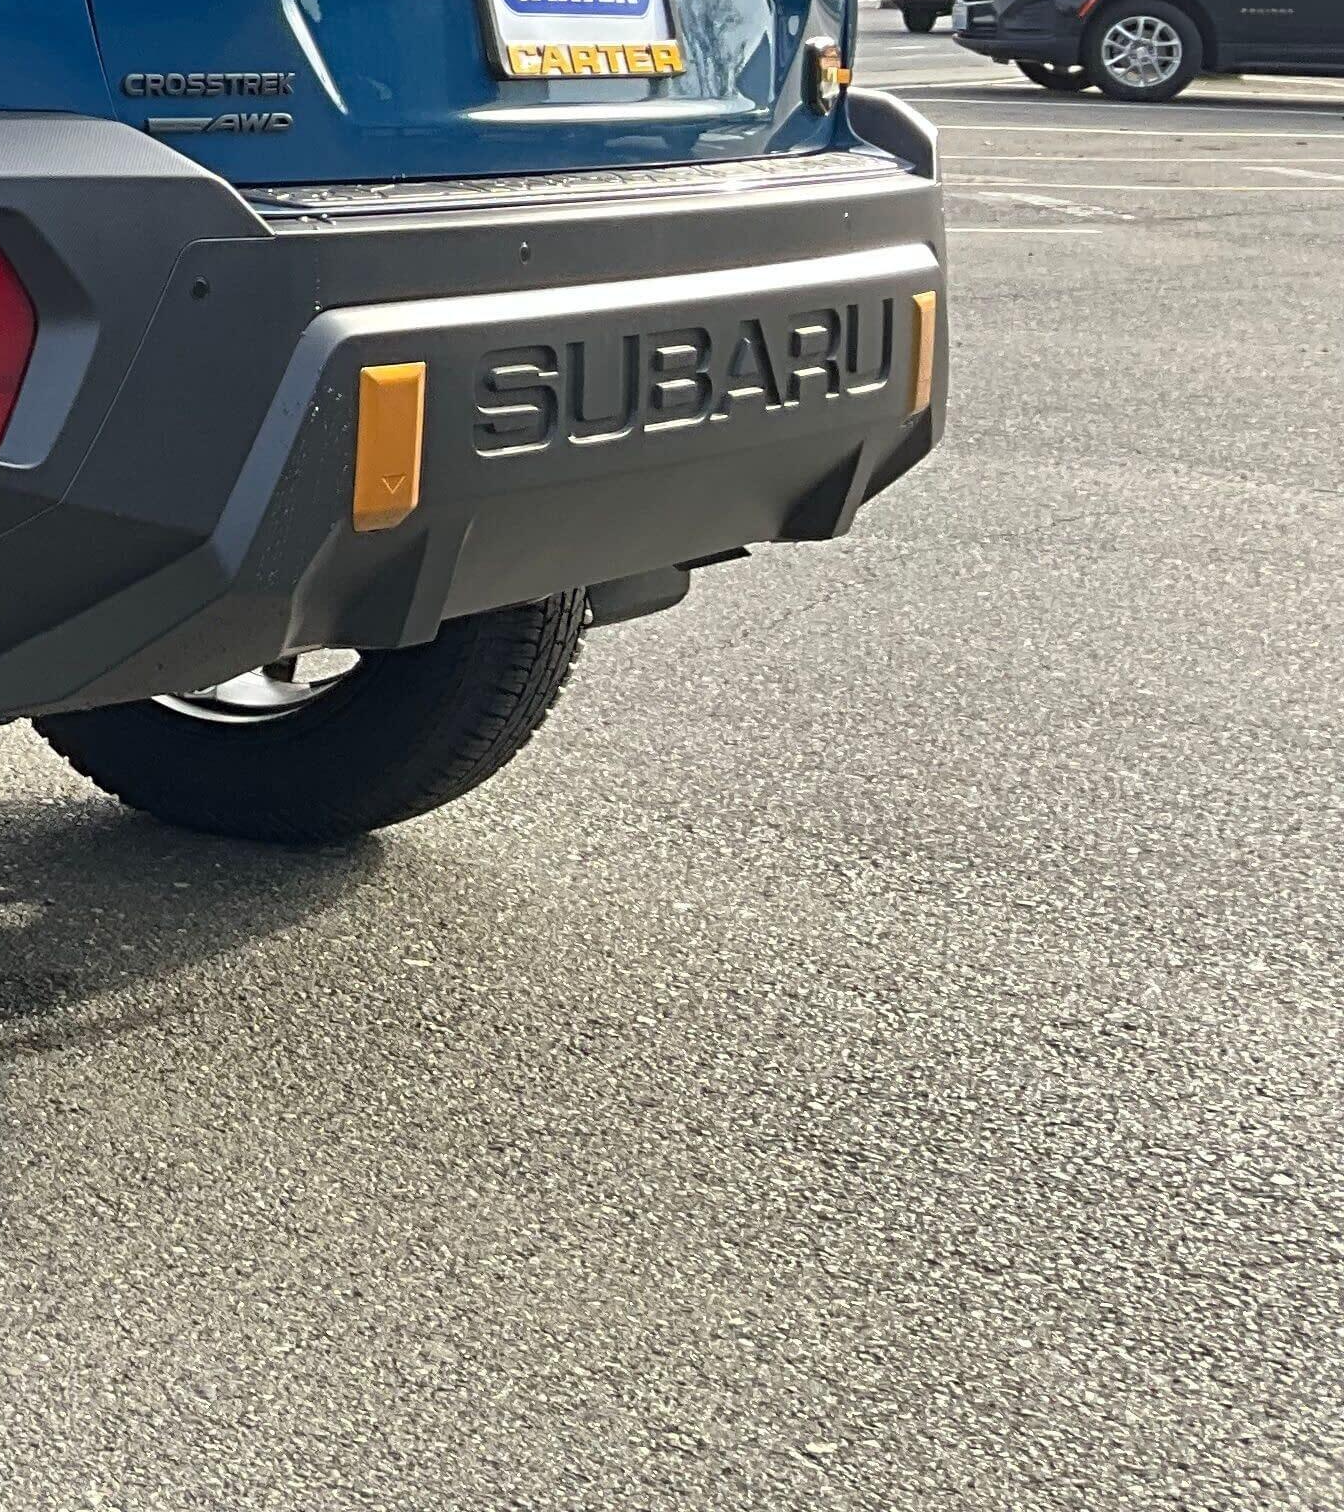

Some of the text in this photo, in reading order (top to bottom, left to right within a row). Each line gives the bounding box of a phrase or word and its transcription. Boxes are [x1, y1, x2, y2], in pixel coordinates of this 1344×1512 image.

[507, 43, 684, 74] CARTER
[123, 72, 296, 98] CROSSTREK
[205, 112, 295, 133] AWD
[473, 298, 894, 458] SUBARU
